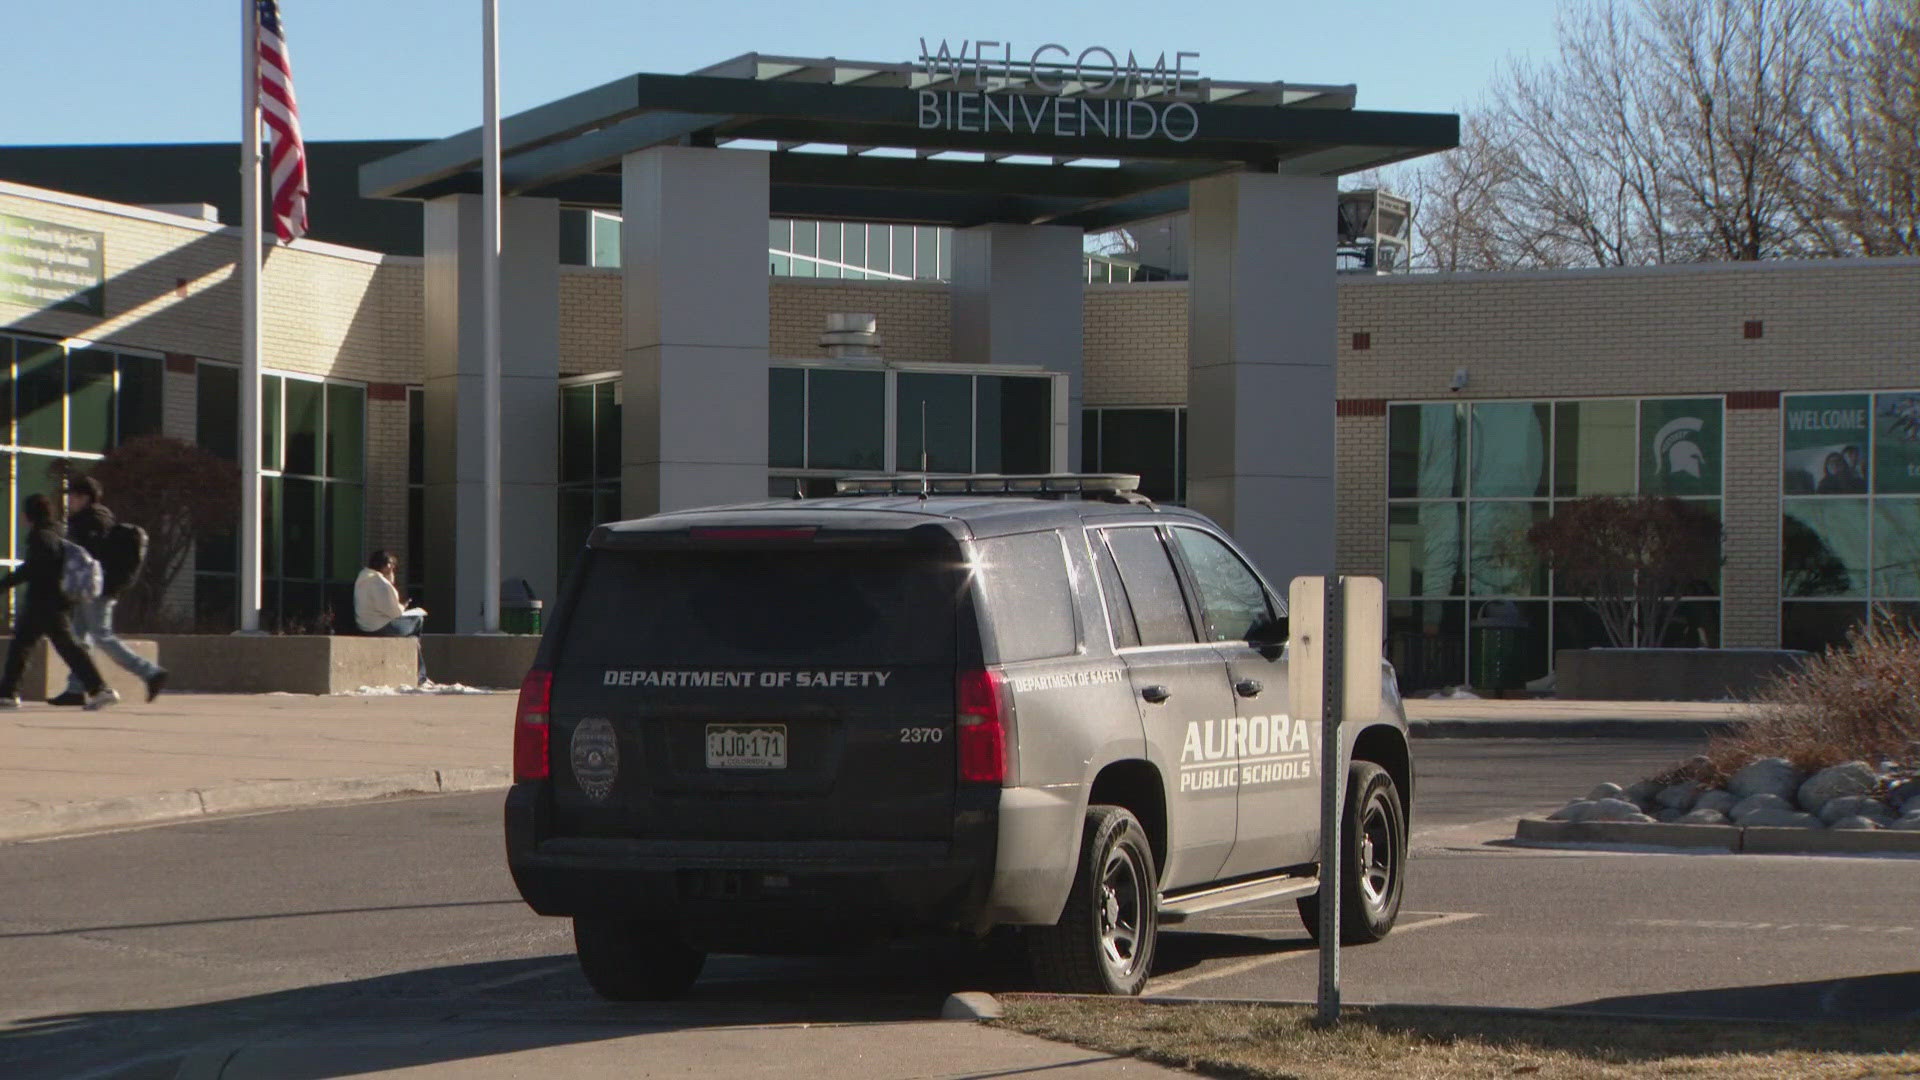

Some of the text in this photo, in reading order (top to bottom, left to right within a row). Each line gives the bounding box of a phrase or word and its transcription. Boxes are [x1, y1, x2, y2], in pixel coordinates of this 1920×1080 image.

[919, 37, 1200, 97] WELCOME
[918, 90, 1199, 142] BIENVENIDO
[1787, 409, 1866, 431] WELCOME
[603, 670, 892, 687] DEPARTMENT OF SAFETY
[1015, 669, 1123, 692] DEPARTMENT OF SAFETY
[900, 727, 943, 743] 2370
[1180, 714, 1310, 762] AURORA
[1180, 760, 1311, 792] PUBLIC SCHOOLS
